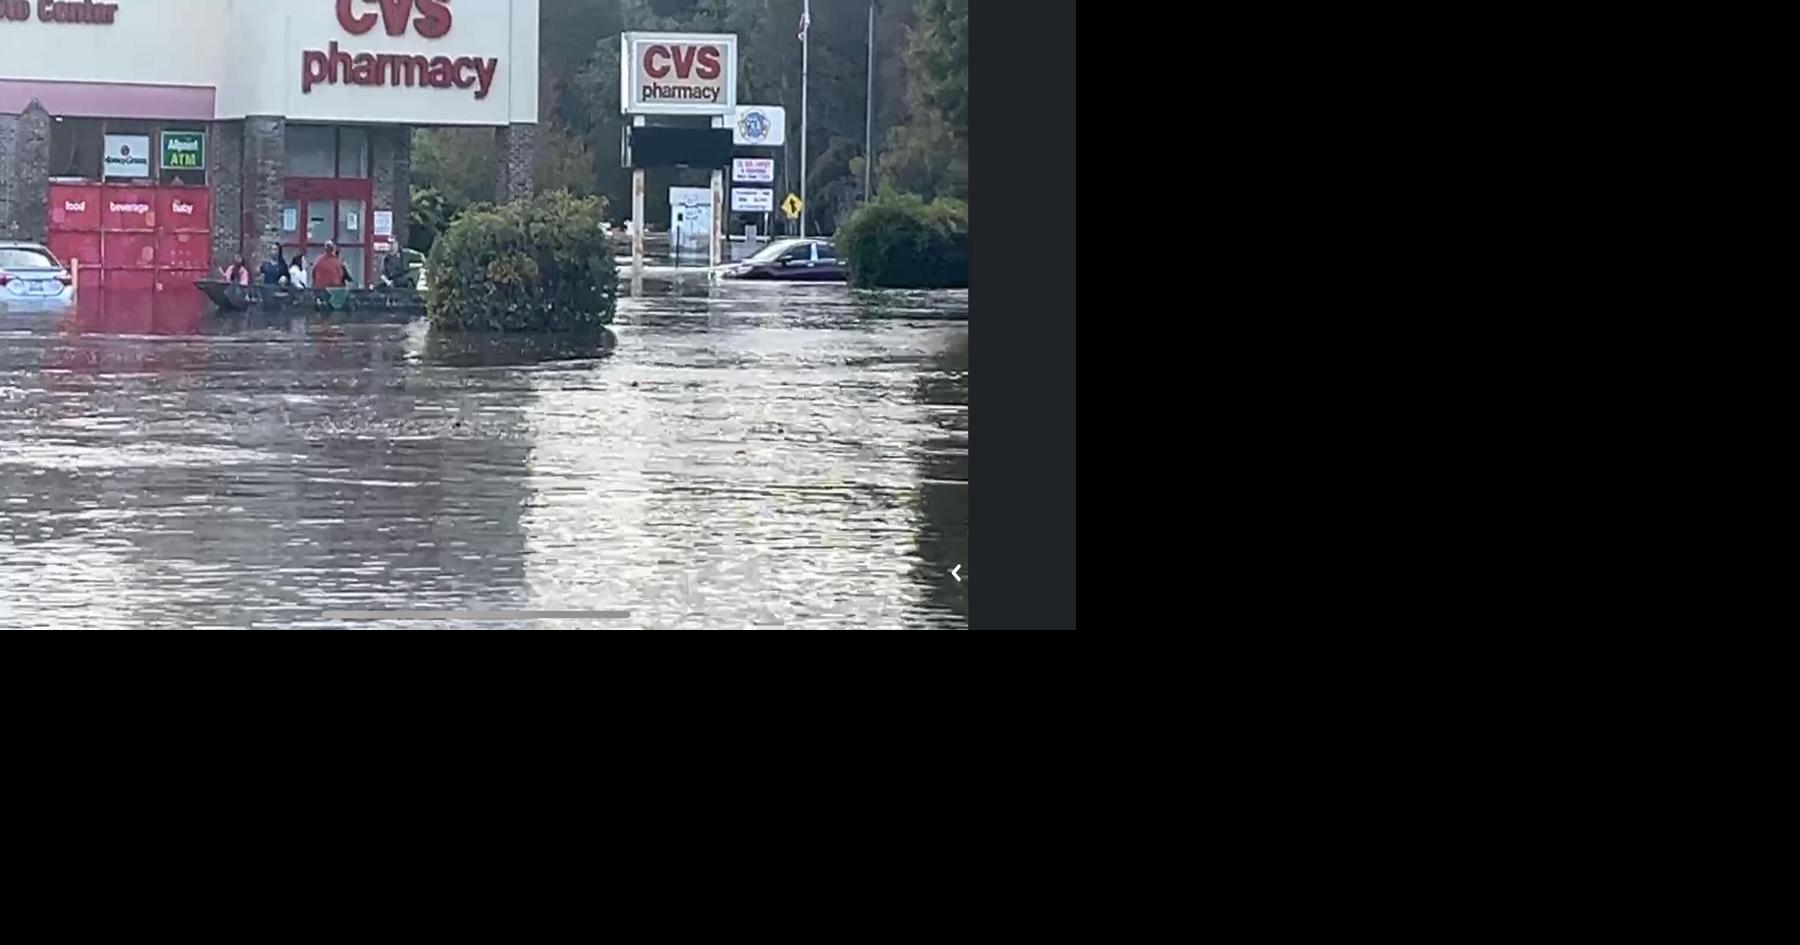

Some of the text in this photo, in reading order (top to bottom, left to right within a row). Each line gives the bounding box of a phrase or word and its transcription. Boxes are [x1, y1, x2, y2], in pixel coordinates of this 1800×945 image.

[37, 0, 118, 24] Center
[336, 0, 452, 38] CVS
[302, 41, 498, 99] pharmacy
[643, 45, 721, 79] CVS
[642, 82, 720, 102] pharmacy
[170, 153, 196, 165] ATM
[65, 201, 85, 211] food
[109, 201, 149, 213] beverage
